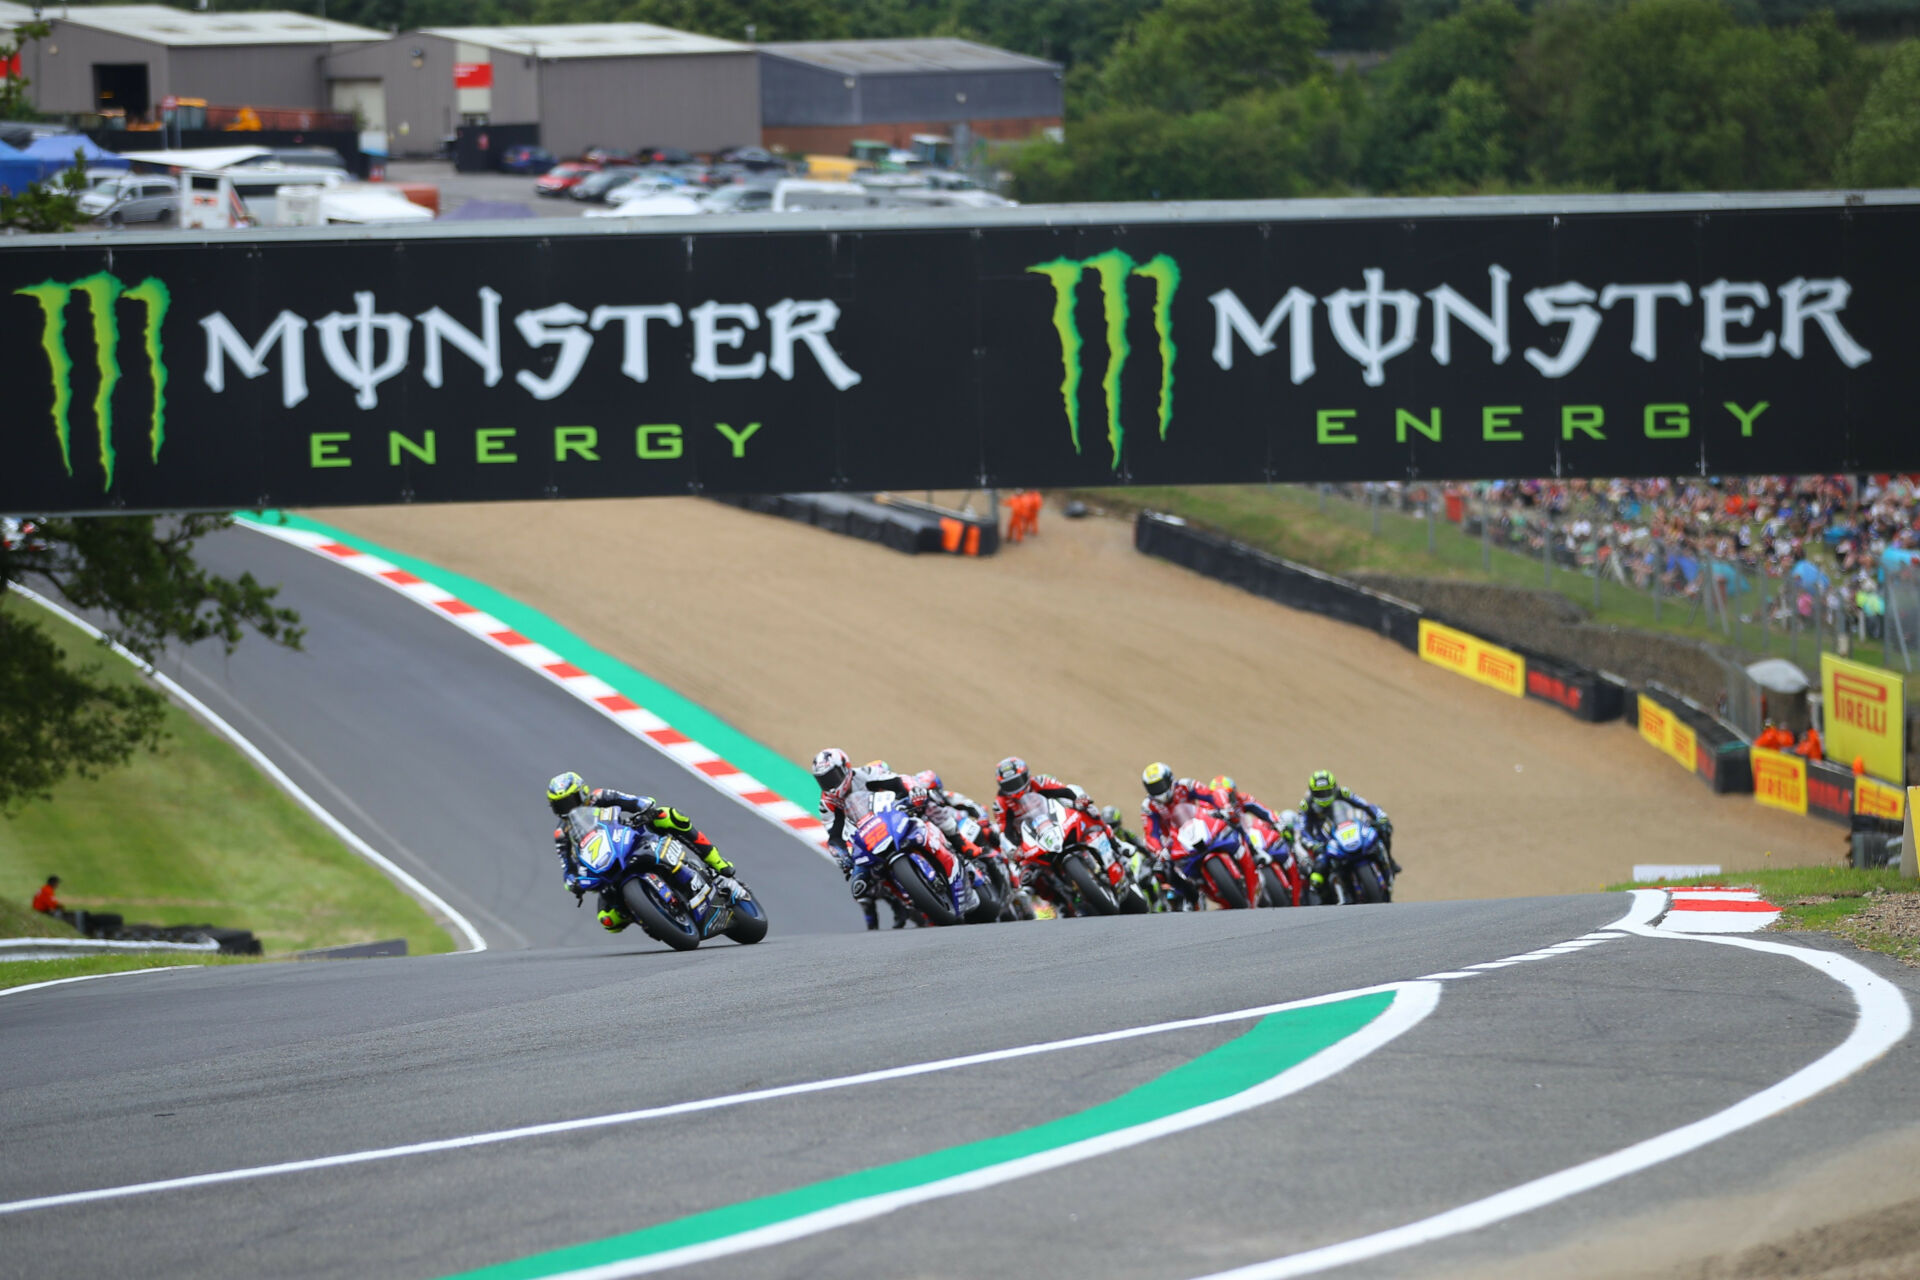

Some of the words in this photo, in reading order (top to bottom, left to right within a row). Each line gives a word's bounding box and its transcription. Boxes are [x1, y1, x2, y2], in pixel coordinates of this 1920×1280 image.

[200, 287, 862, 409] MONSTER
[1209, 265, 1871, 387] MONSTER
[310, 422, 761, 468] ENERGY
[1316, 401, 1769, 445] ENERGY
[1427, 632, 1466, 666] PIRELLI
[1833, 671, 1888, 738] PIRELLI
[864, 821, 889, 852] 52
